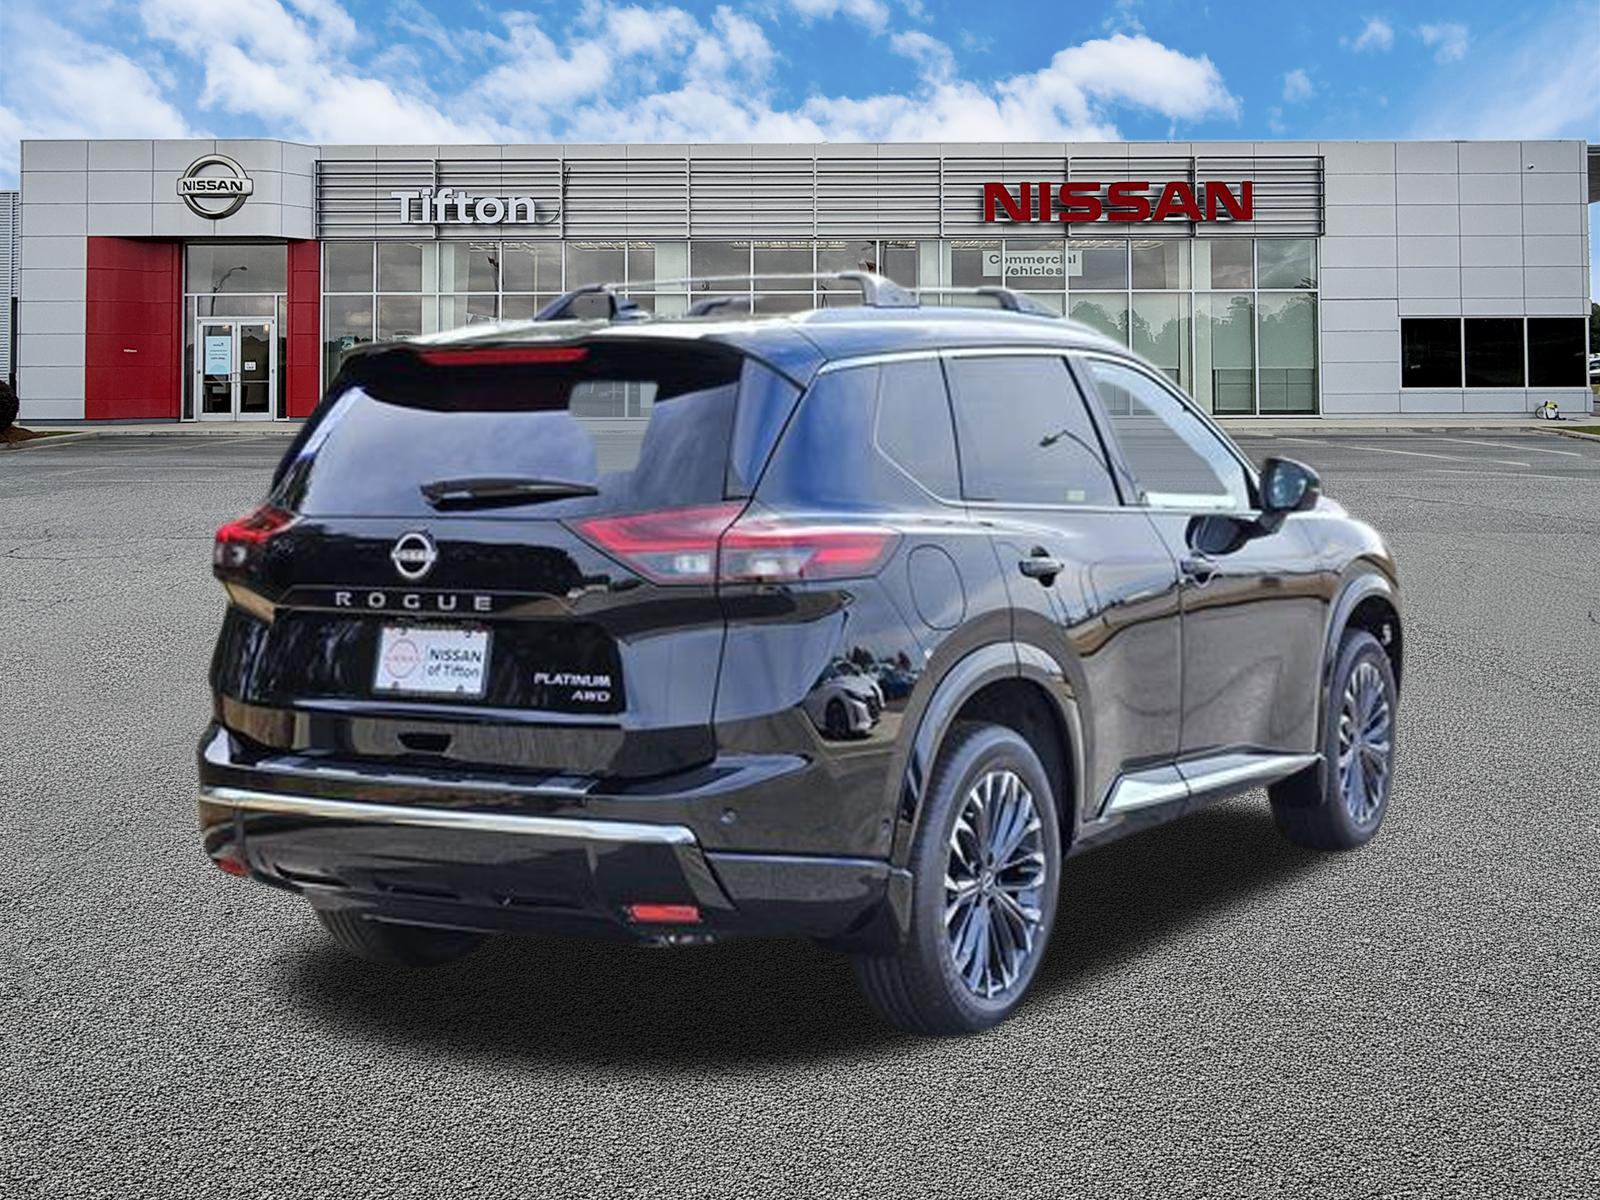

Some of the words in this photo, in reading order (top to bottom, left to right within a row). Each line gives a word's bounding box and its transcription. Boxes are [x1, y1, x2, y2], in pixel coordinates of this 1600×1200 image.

[183, 180, 243, 192] NISSAN
[390, 188, 536, 224] Tifton
[983, 180, 1254, 222] NISSAN
[334, 591, 493, 612] ROGUE
[430, 648, 482, 664] NISSAN
[427, 663, 442, 677] of
[533, 672, 612, 688] PLATINUM
[570, 689, 612, 703] AWD
